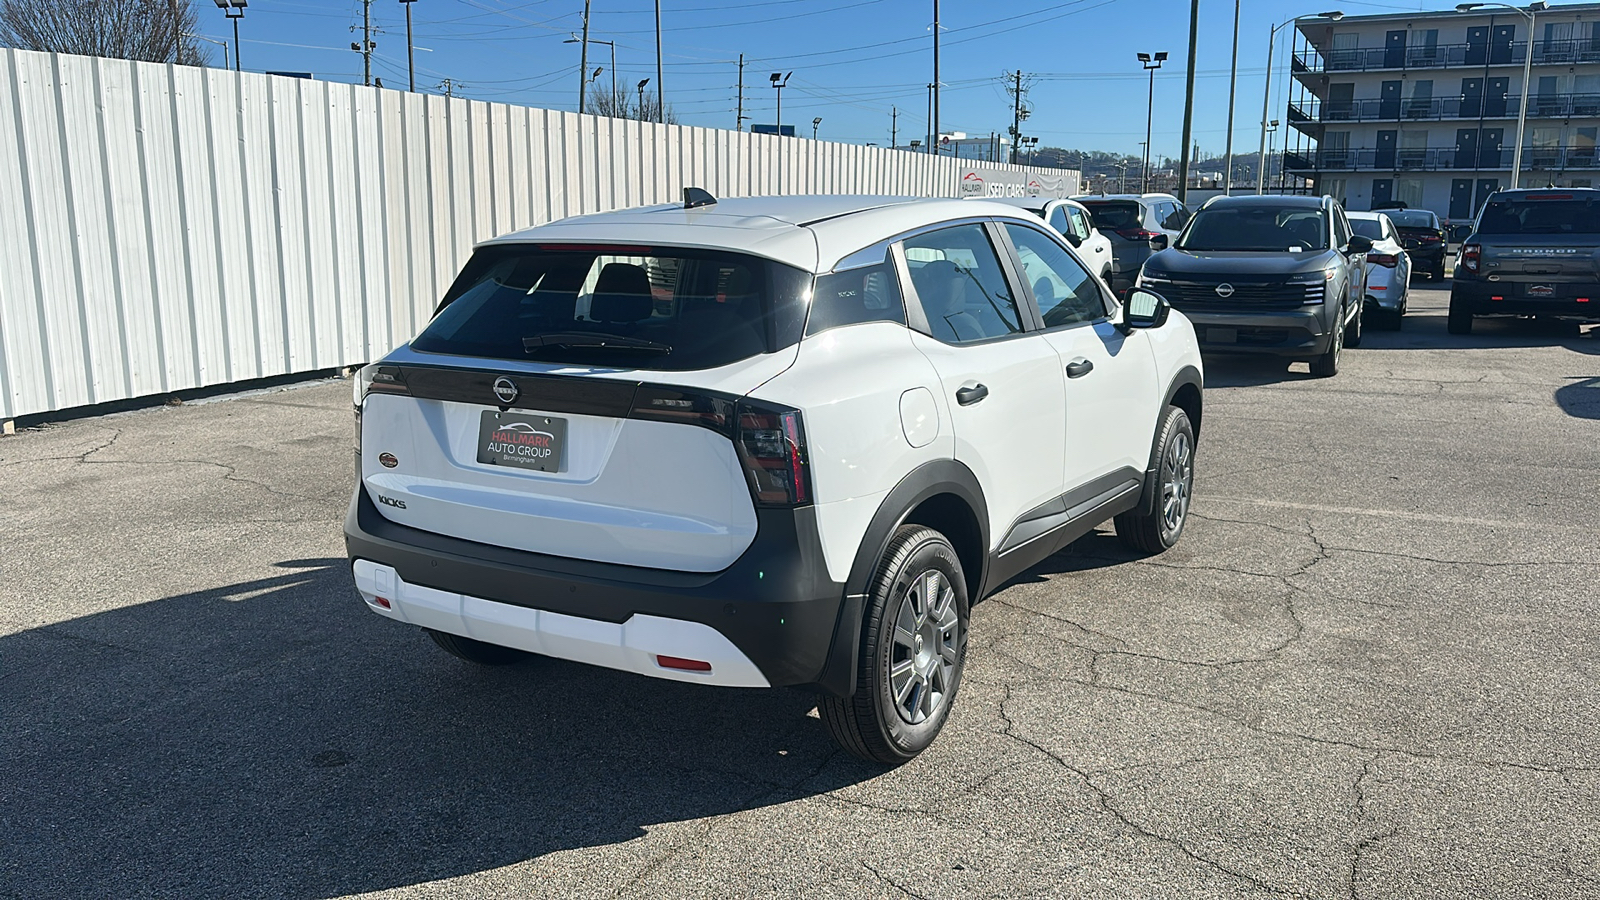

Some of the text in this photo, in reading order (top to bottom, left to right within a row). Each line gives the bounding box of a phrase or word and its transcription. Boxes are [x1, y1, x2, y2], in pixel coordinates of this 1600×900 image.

[985, 183, 1025, 198] USED CARS
[492, 431, 550, 447] HALLMARK
[487, 442, 552, 458] AUTO GROUP
[503, 454, 536, 464] Birmingham
[378, 494, 407, 510] KICKS
